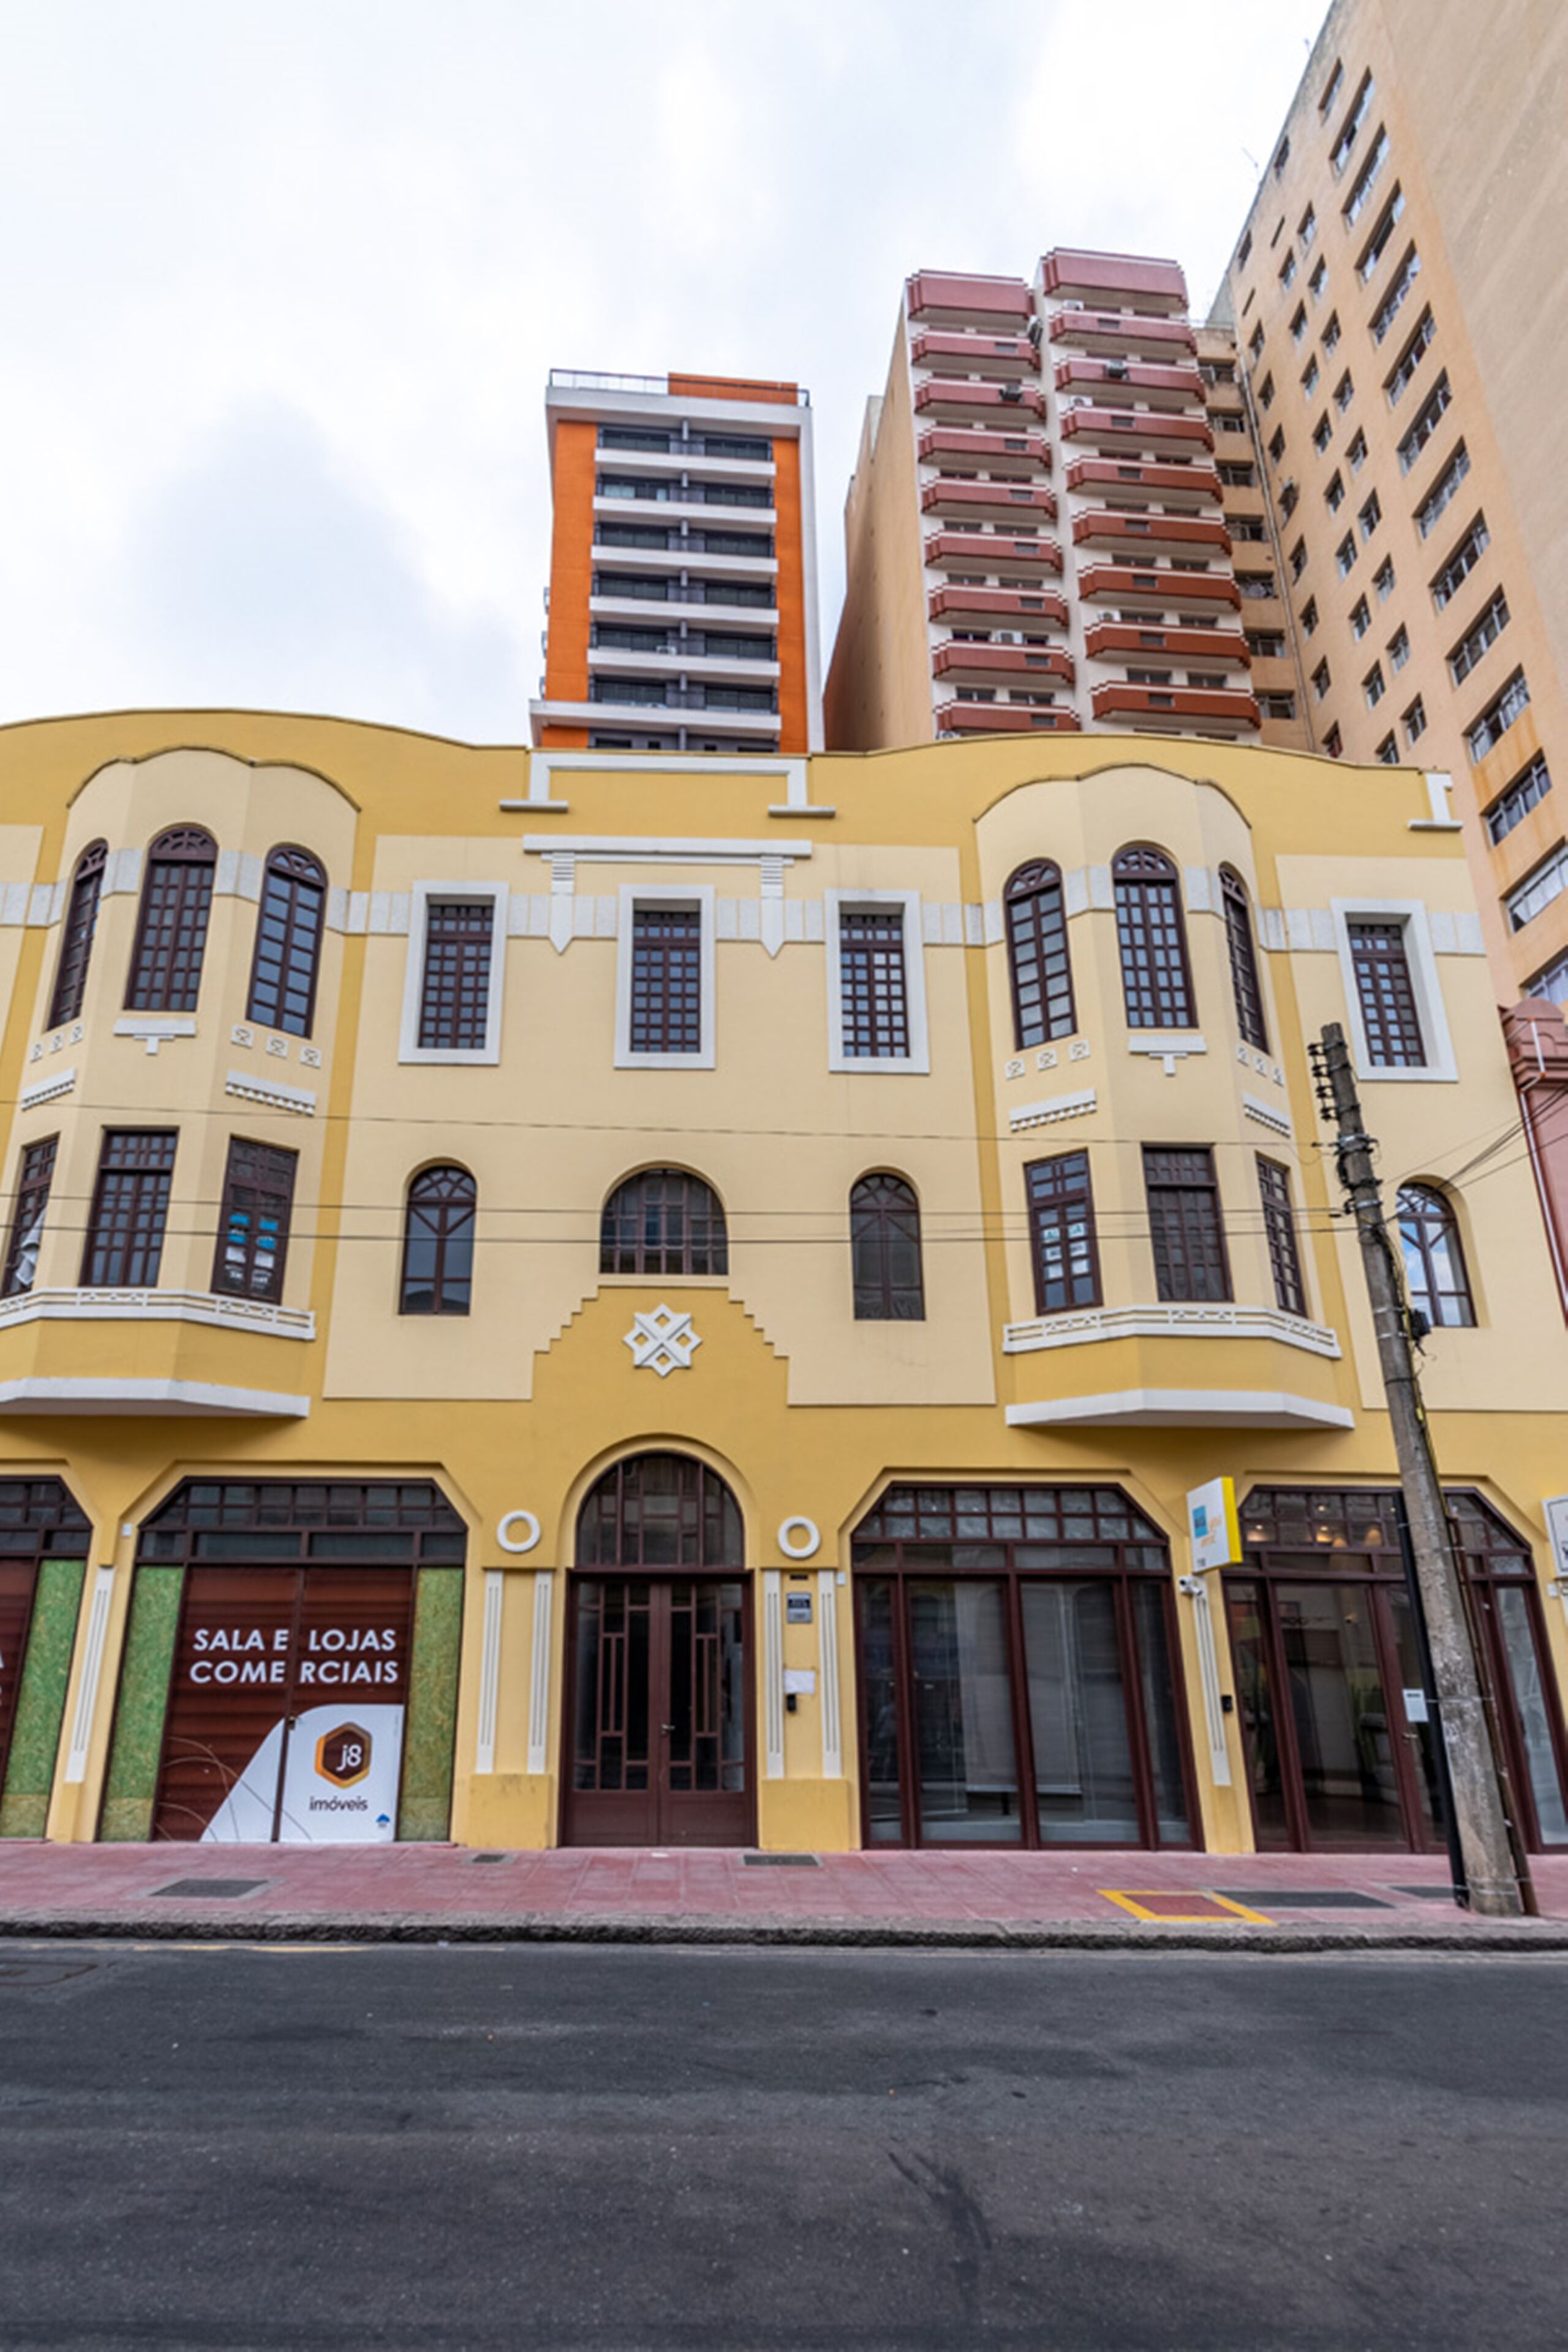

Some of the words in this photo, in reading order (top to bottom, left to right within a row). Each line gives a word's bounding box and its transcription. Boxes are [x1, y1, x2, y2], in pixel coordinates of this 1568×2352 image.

[192, 1629, 265, 1651] SALA
[273, 1629, 289, 1651] E
[309, 1629, 396, 1651] LOJAS
[336, 1744, 362, 1771] j8
[309, 1795, 368, 1811] imóveis
